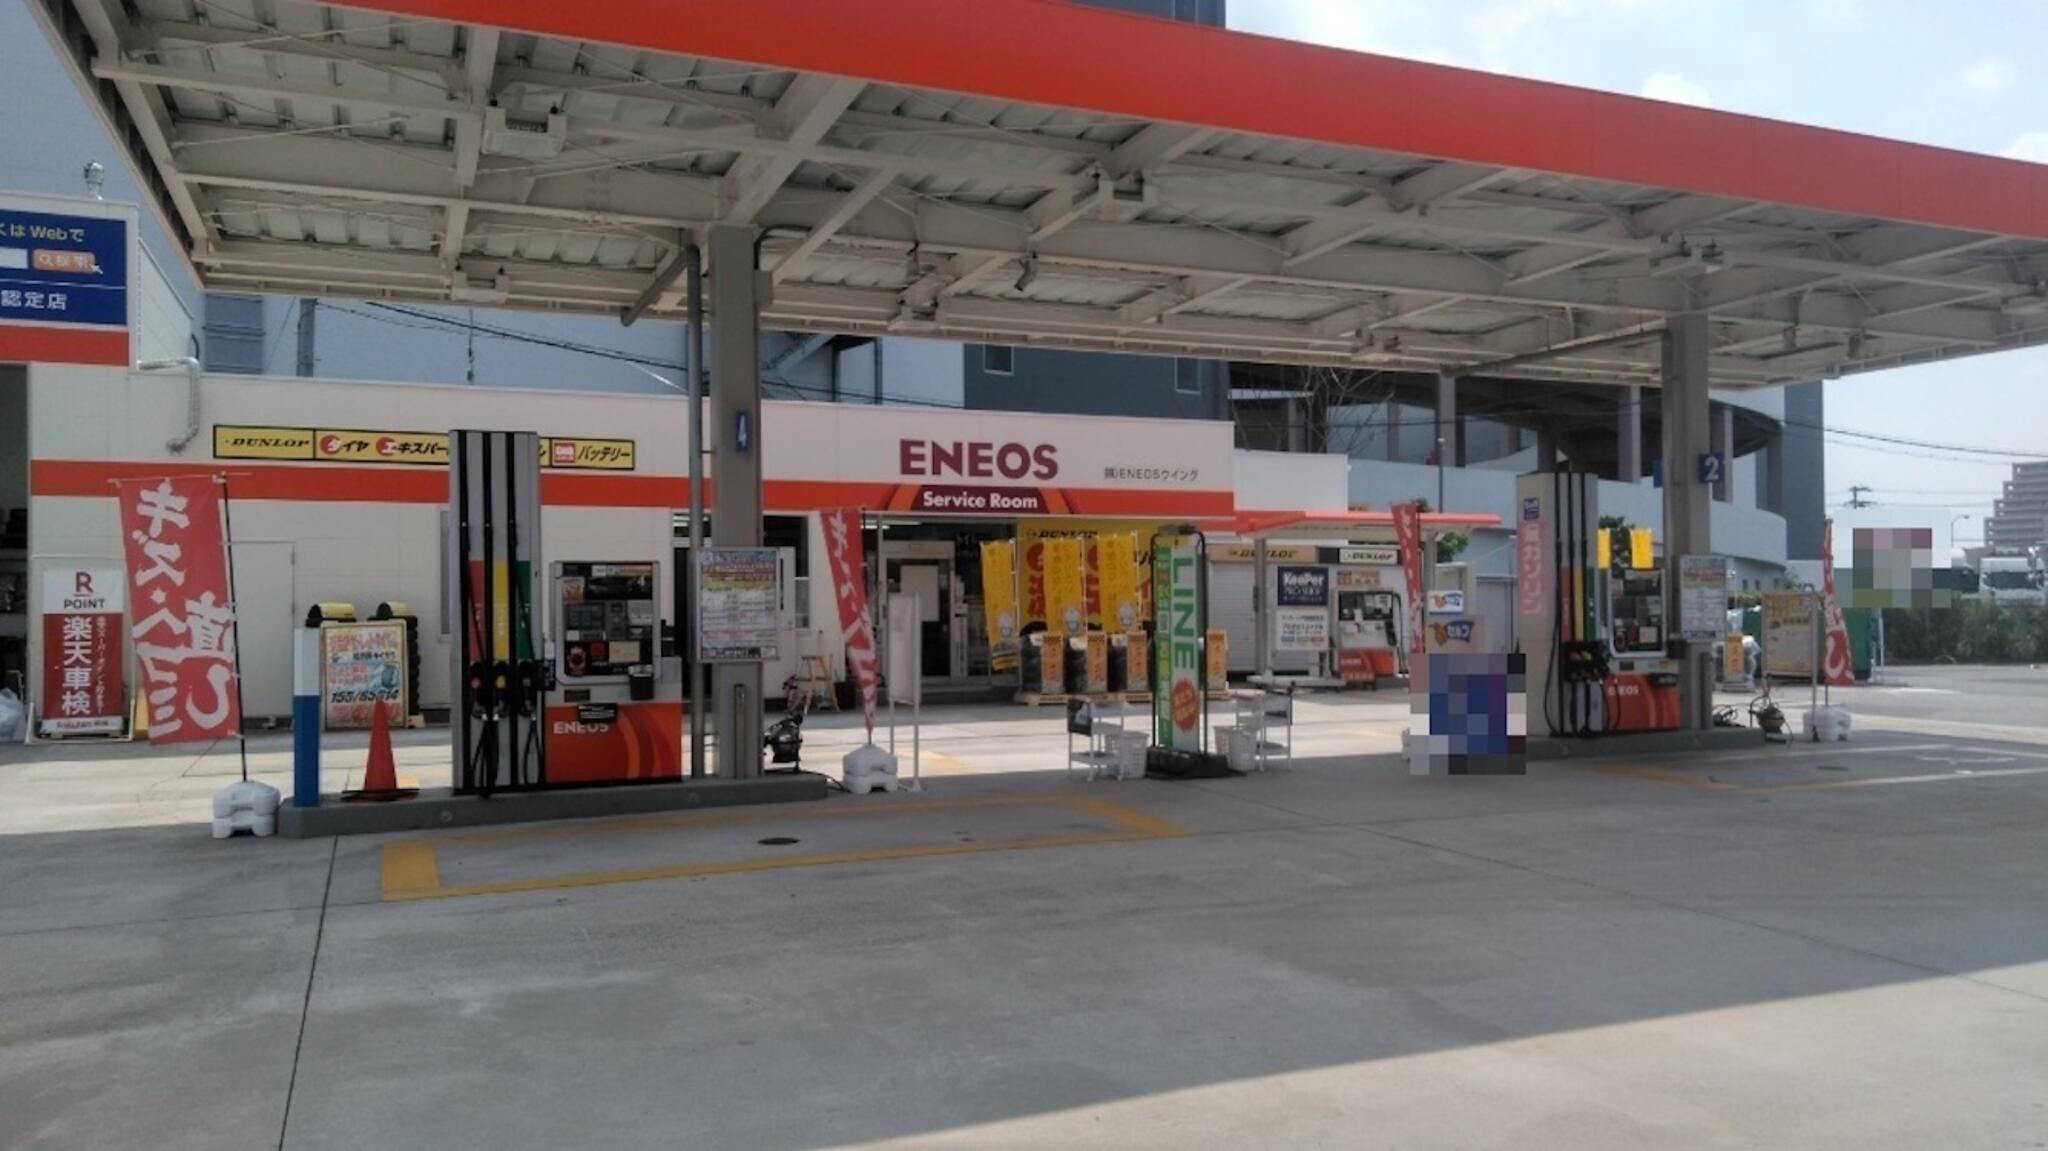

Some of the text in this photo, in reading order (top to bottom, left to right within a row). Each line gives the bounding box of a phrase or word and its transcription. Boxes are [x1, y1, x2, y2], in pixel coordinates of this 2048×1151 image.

[0, 290, 68, 310] 認定店
[738, 414, 747, 447] 4
[232, 438, 310, 447] DUNLOP
[577, 446, 631, 462] バッテリー
[900, 439, 1059, 480] ENEOS
[1703, 456, 1720, 481] 2
[923, 491, 1038, 510] Service Room
[1352, 552, 1394, 561] DUNLOP
[75, 571, 93, 592] R
[64, 599, 106, 609] POINT
[1172, 557, 1195, 670] LINE
[61, 616, 92, 716] 楽天車検
